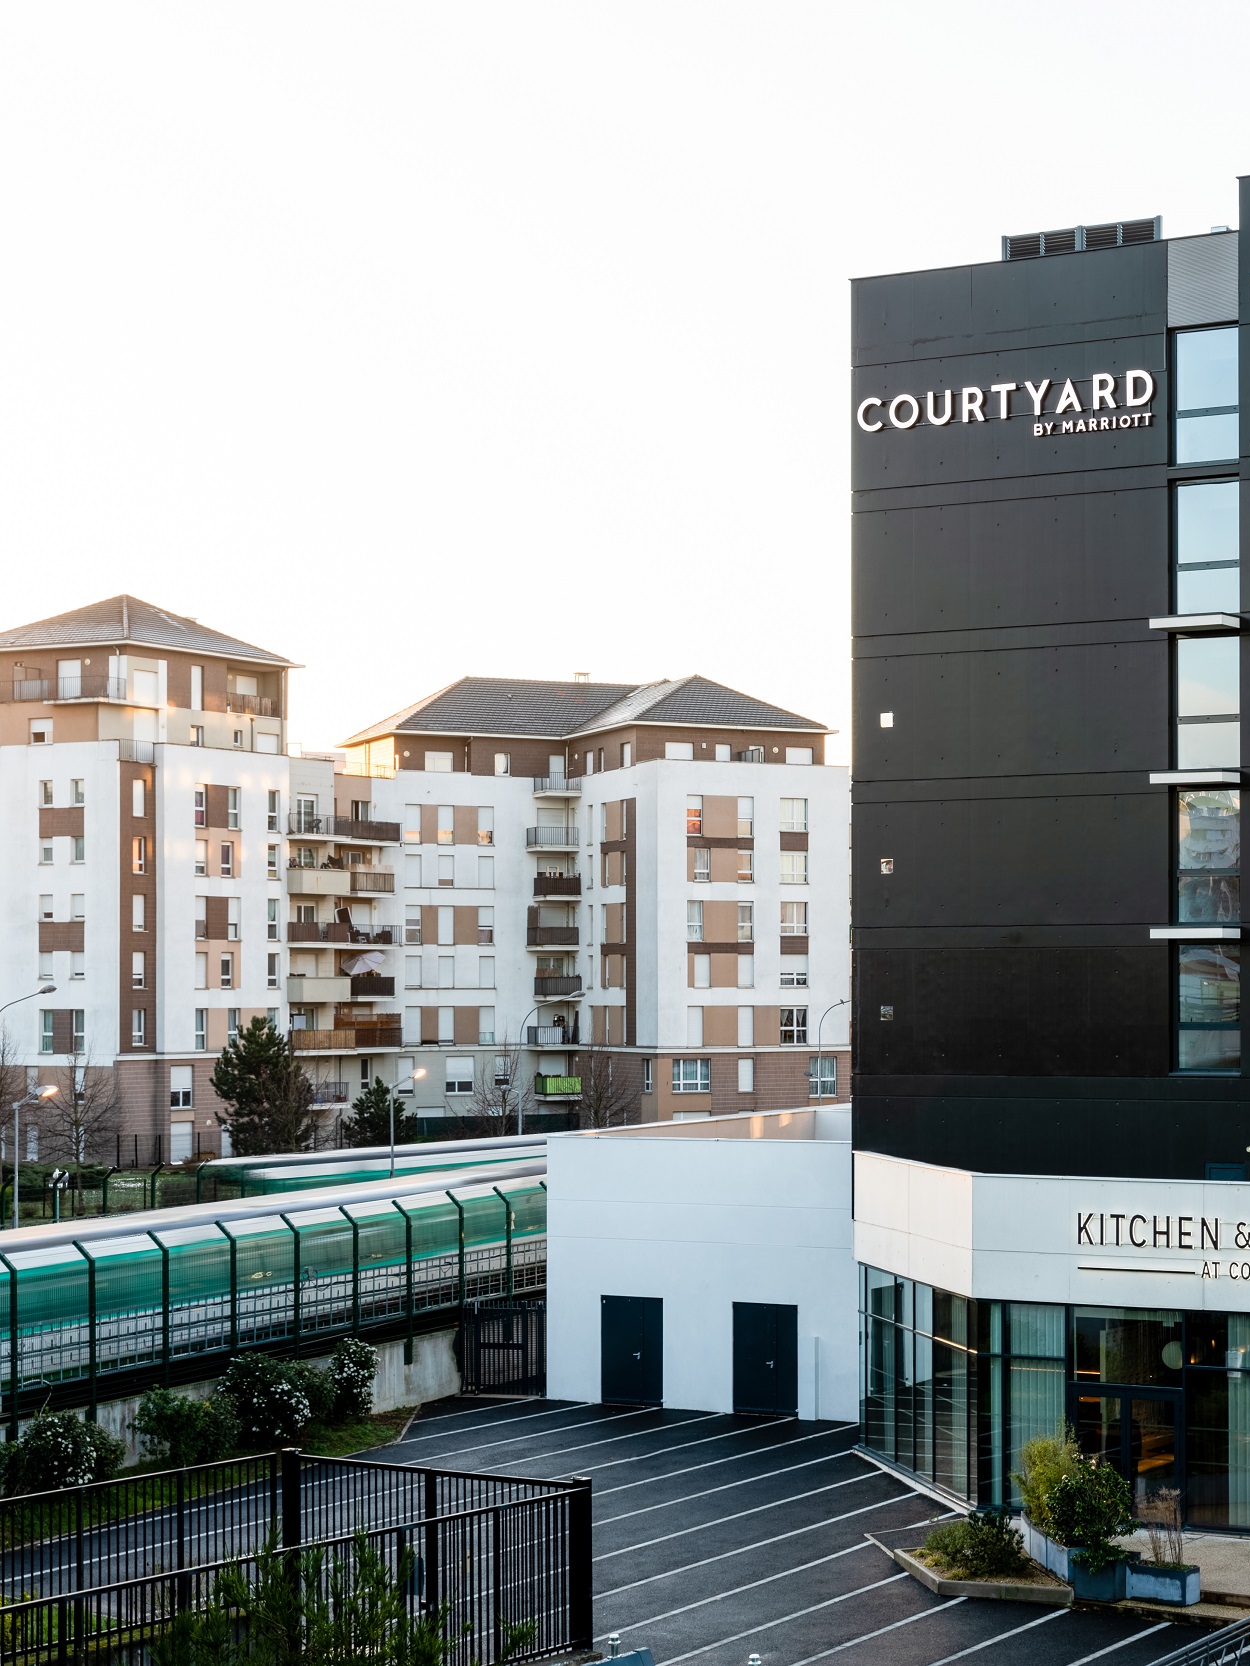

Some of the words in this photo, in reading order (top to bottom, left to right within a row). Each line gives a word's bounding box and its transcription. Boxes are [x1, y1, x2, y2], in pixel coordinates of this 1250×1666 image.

[857, 369, 1154, 432] COURTYARD
[1033, 422, 1054, 437] BY
[1062, 412, 1153, 434] MARRIOTT
[1077, 1212, 1221, 1250] KITCHEN
[1201, 1261, 1221, 1279] AT
